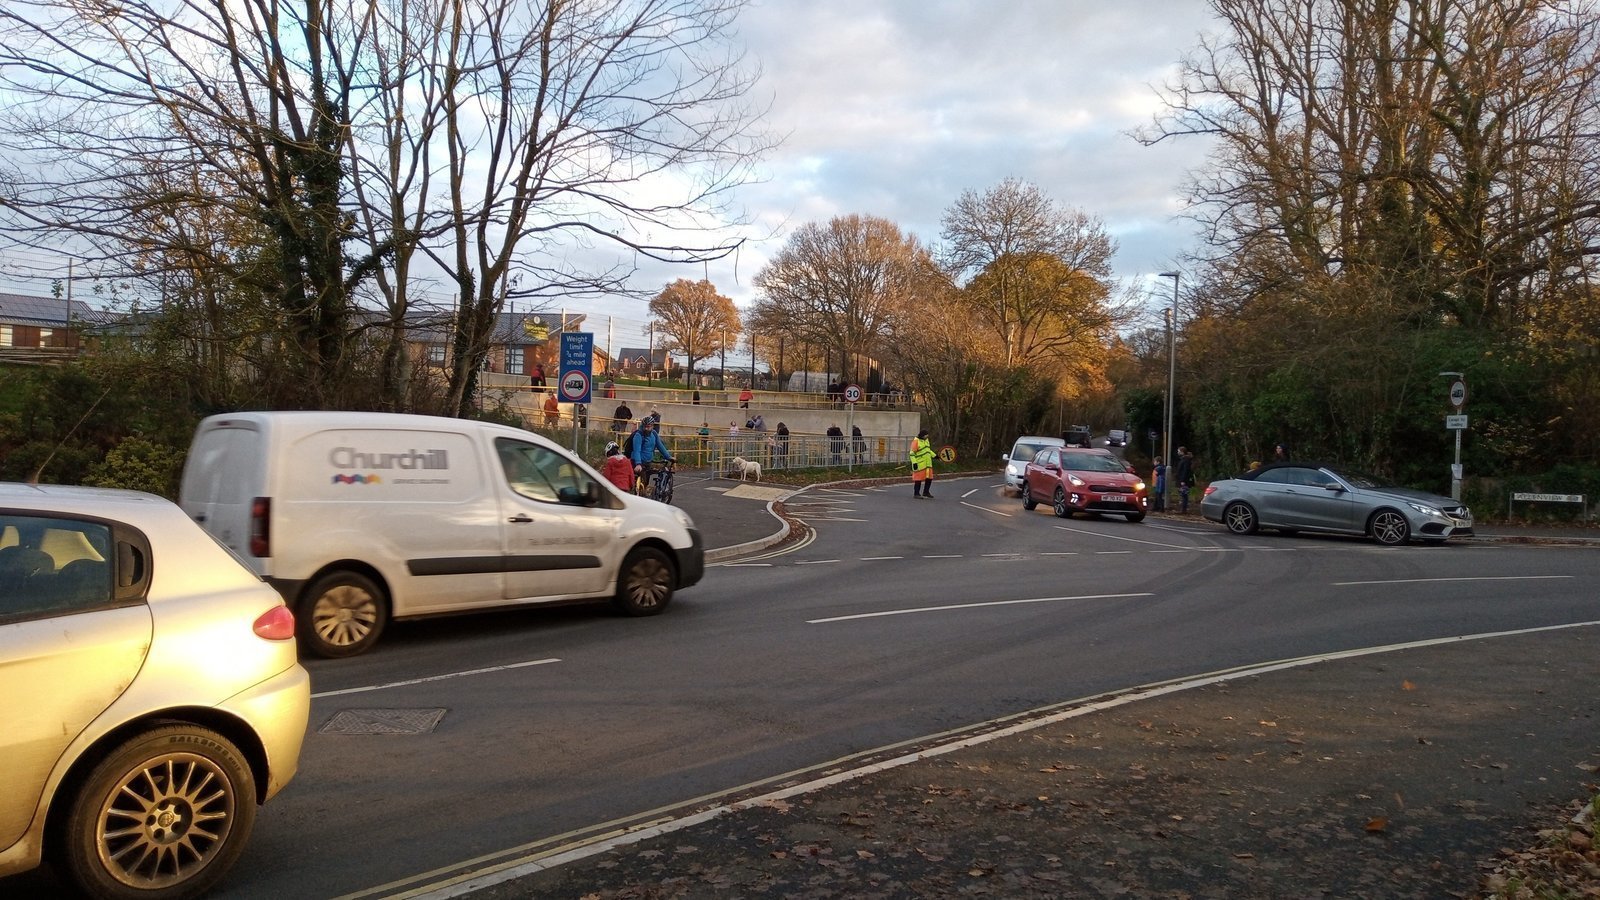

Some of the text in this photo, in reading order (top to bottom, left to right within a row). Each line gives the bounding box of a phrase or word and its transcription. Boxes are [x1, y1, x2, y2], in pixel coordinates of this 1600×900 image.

[566, 335, 588, 344] Weight
[846, 389, 859, 398] 30
[328, 446, 449, 470] Churchill
